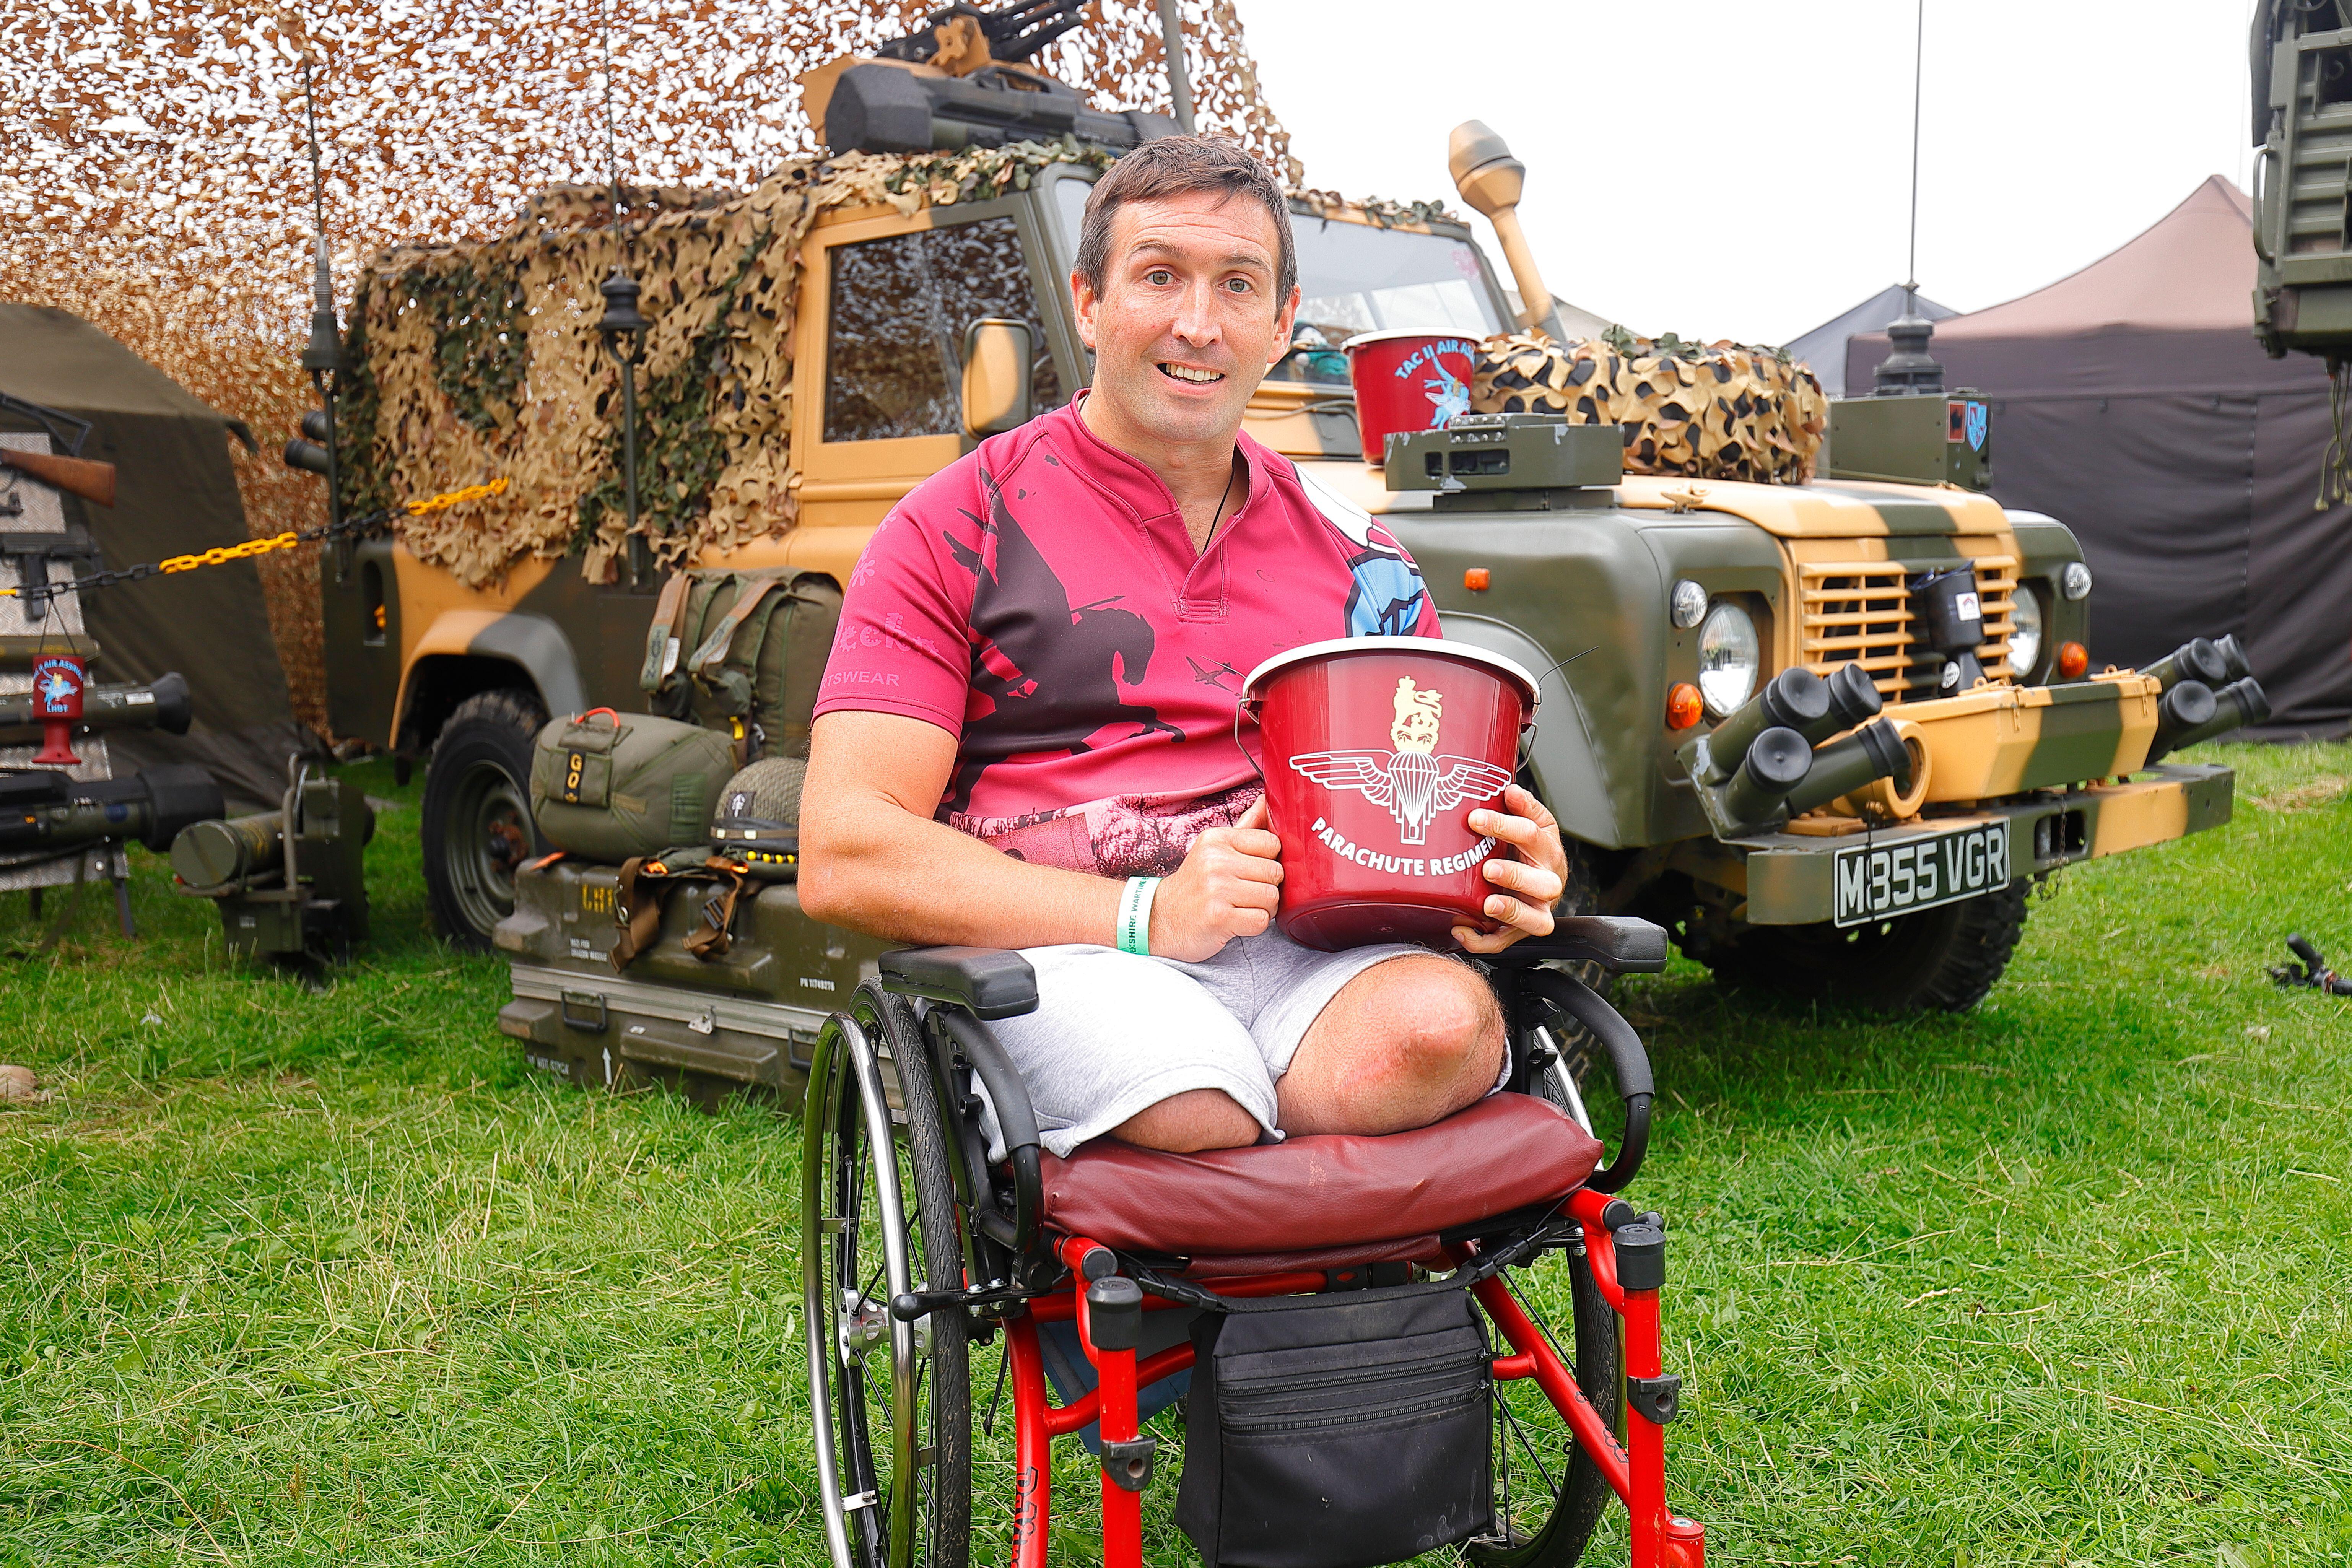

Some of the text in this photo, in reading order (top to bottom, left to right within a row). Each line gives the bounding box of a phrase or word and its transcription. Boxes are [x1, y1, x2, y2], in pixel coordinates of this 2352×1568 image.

[1394, 352, 1423, 379] TAC
[1436, 339, 1459, 355] AIR
[44, 659, 57, 669] AIR
[1311, 816, 1496, 876] PARACHUTE REGIMEN
[1840, 828, 2004, 918] M855 VGR
[1131, 880, 1147, 912] WARTIME
